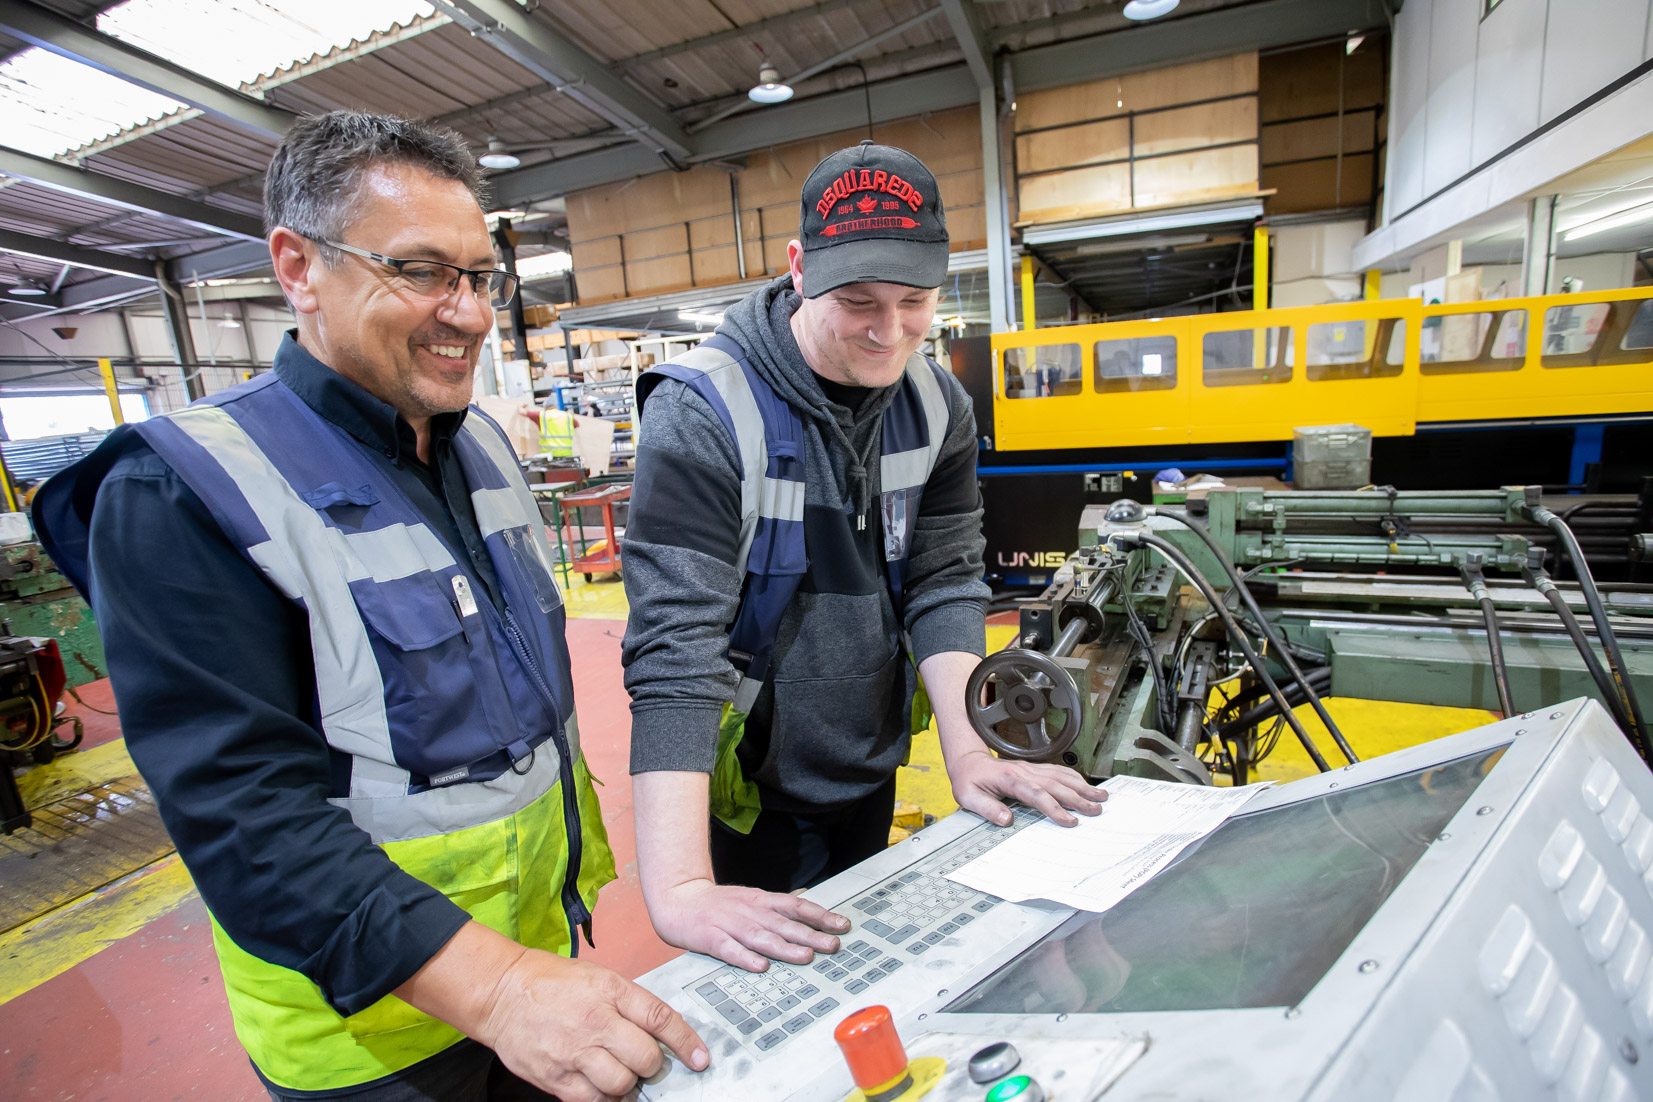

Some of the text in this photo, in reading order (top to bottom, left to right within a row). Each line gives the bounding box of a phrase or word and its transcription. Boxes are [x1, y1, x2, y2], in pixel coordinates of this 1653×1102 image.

[816, 168, 924, 220] DSQUARED2
[836, 218, 902, 234] BROTHERHOOD
[998, 552, 1069, 568] UNIS
[434, 771, 463, 784] PORTWEST
[1120, 876, 1137, 889] Sheet
